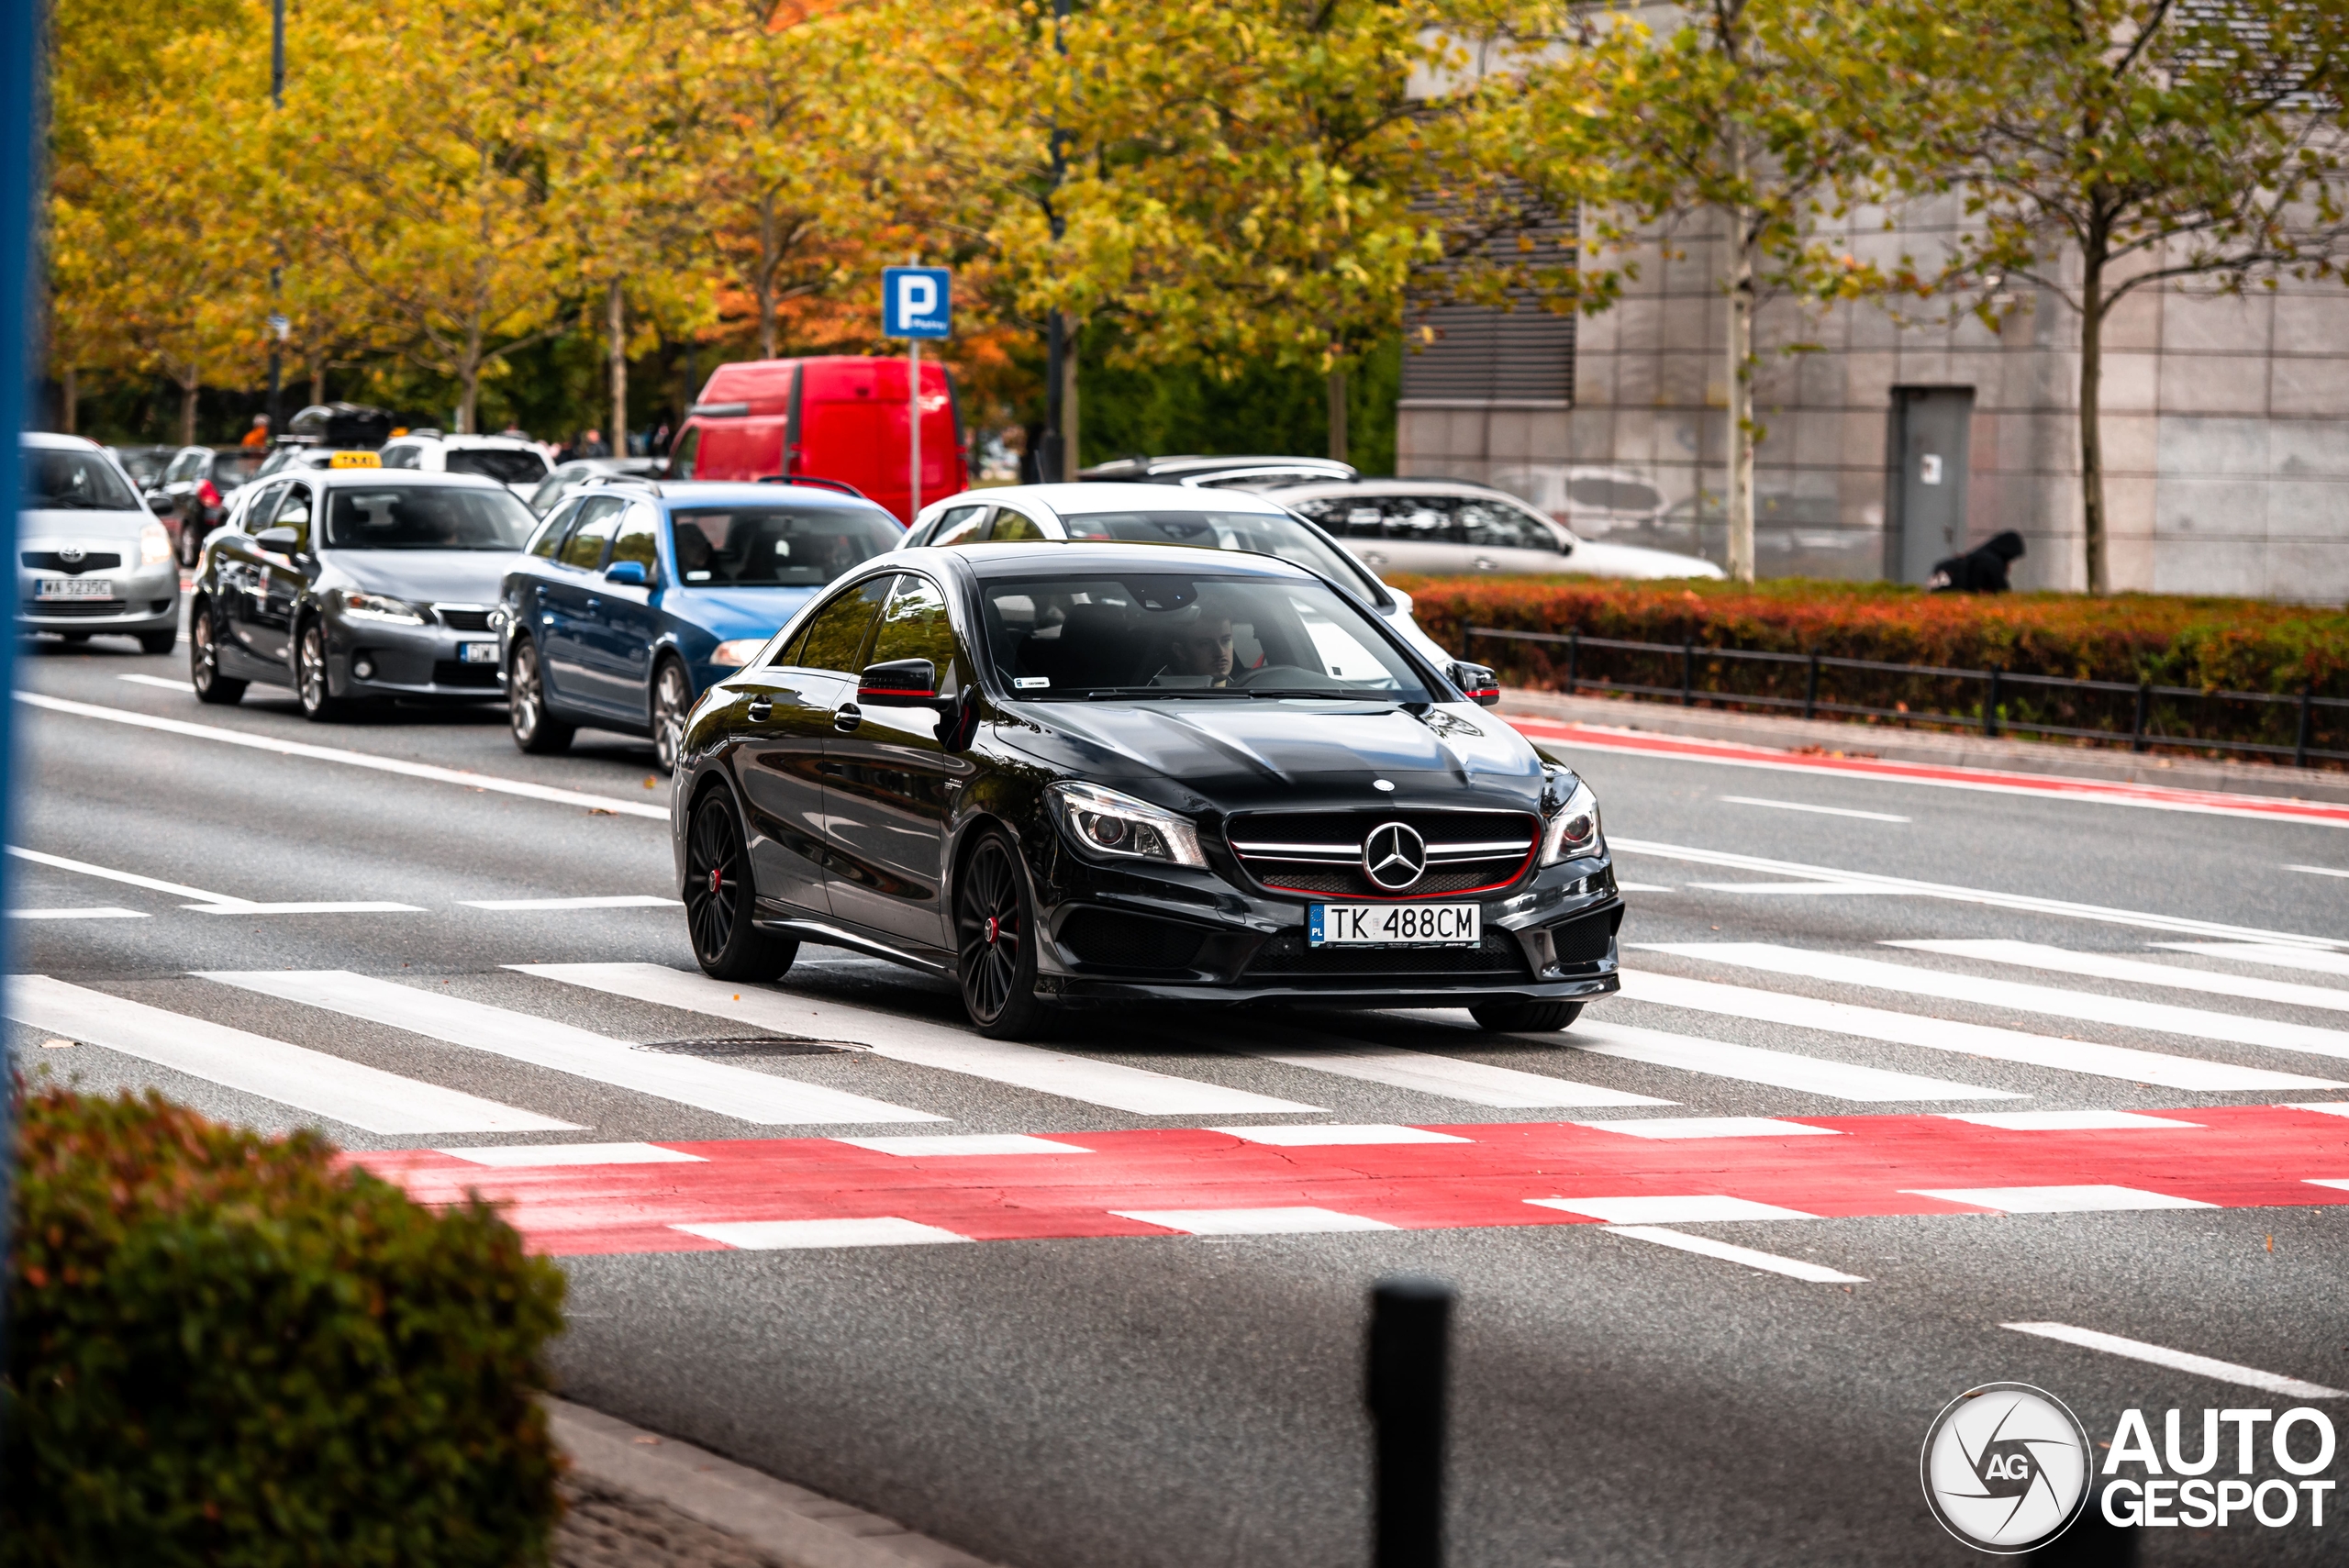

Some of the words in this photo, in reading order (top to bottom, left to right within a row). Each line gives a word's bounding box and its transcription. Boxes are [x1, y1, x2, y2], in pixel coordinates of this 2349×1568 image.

[898, 275, 937, 329] P
[343, 456, 373, 465] TAXI
[1311, 928, 1322, 936] PL
[1331, 908, 1369, 938] TK
[1383, 908, 1472, 938] 488CM
